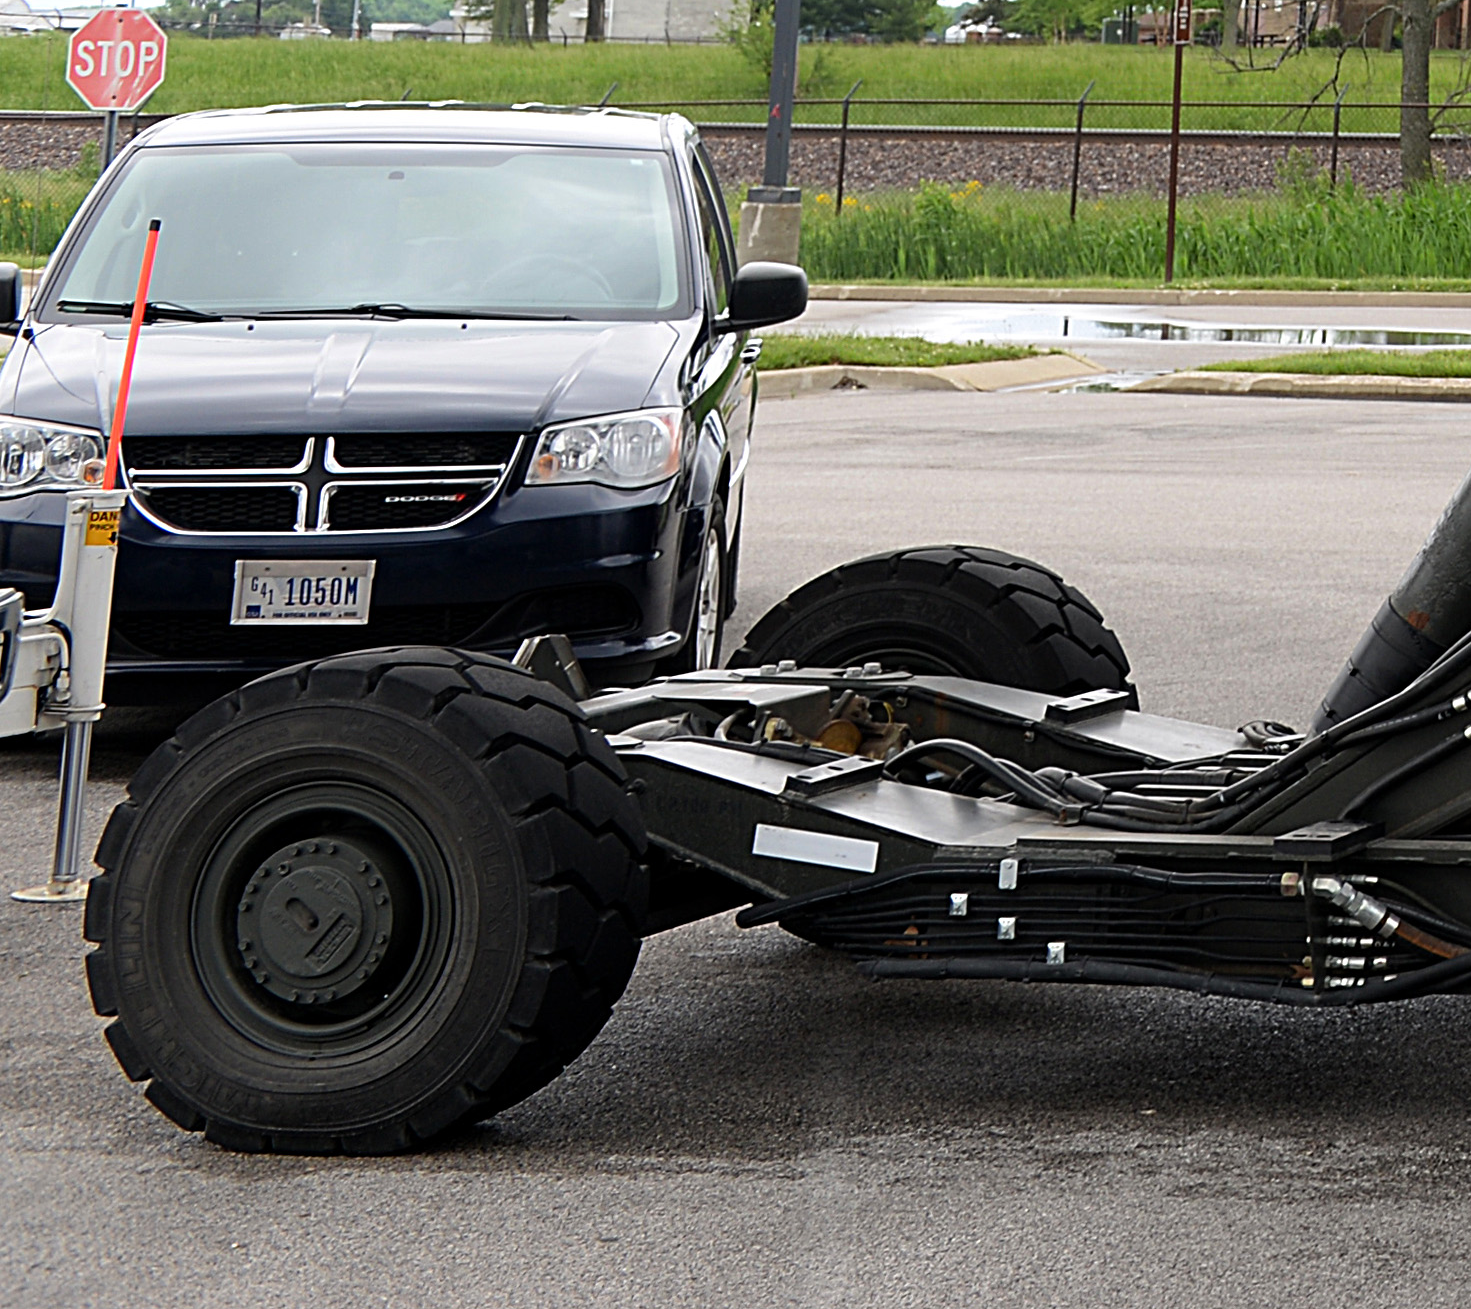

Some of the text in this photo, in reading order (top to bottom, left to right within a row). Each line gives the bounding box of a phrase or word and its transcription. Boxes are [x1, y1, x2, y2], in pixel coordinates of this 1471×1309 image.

[74, 40, 159, 78] STOP
[385, 494, 458, 503] DODGE
[284, 576, 359, 607] 1050M
